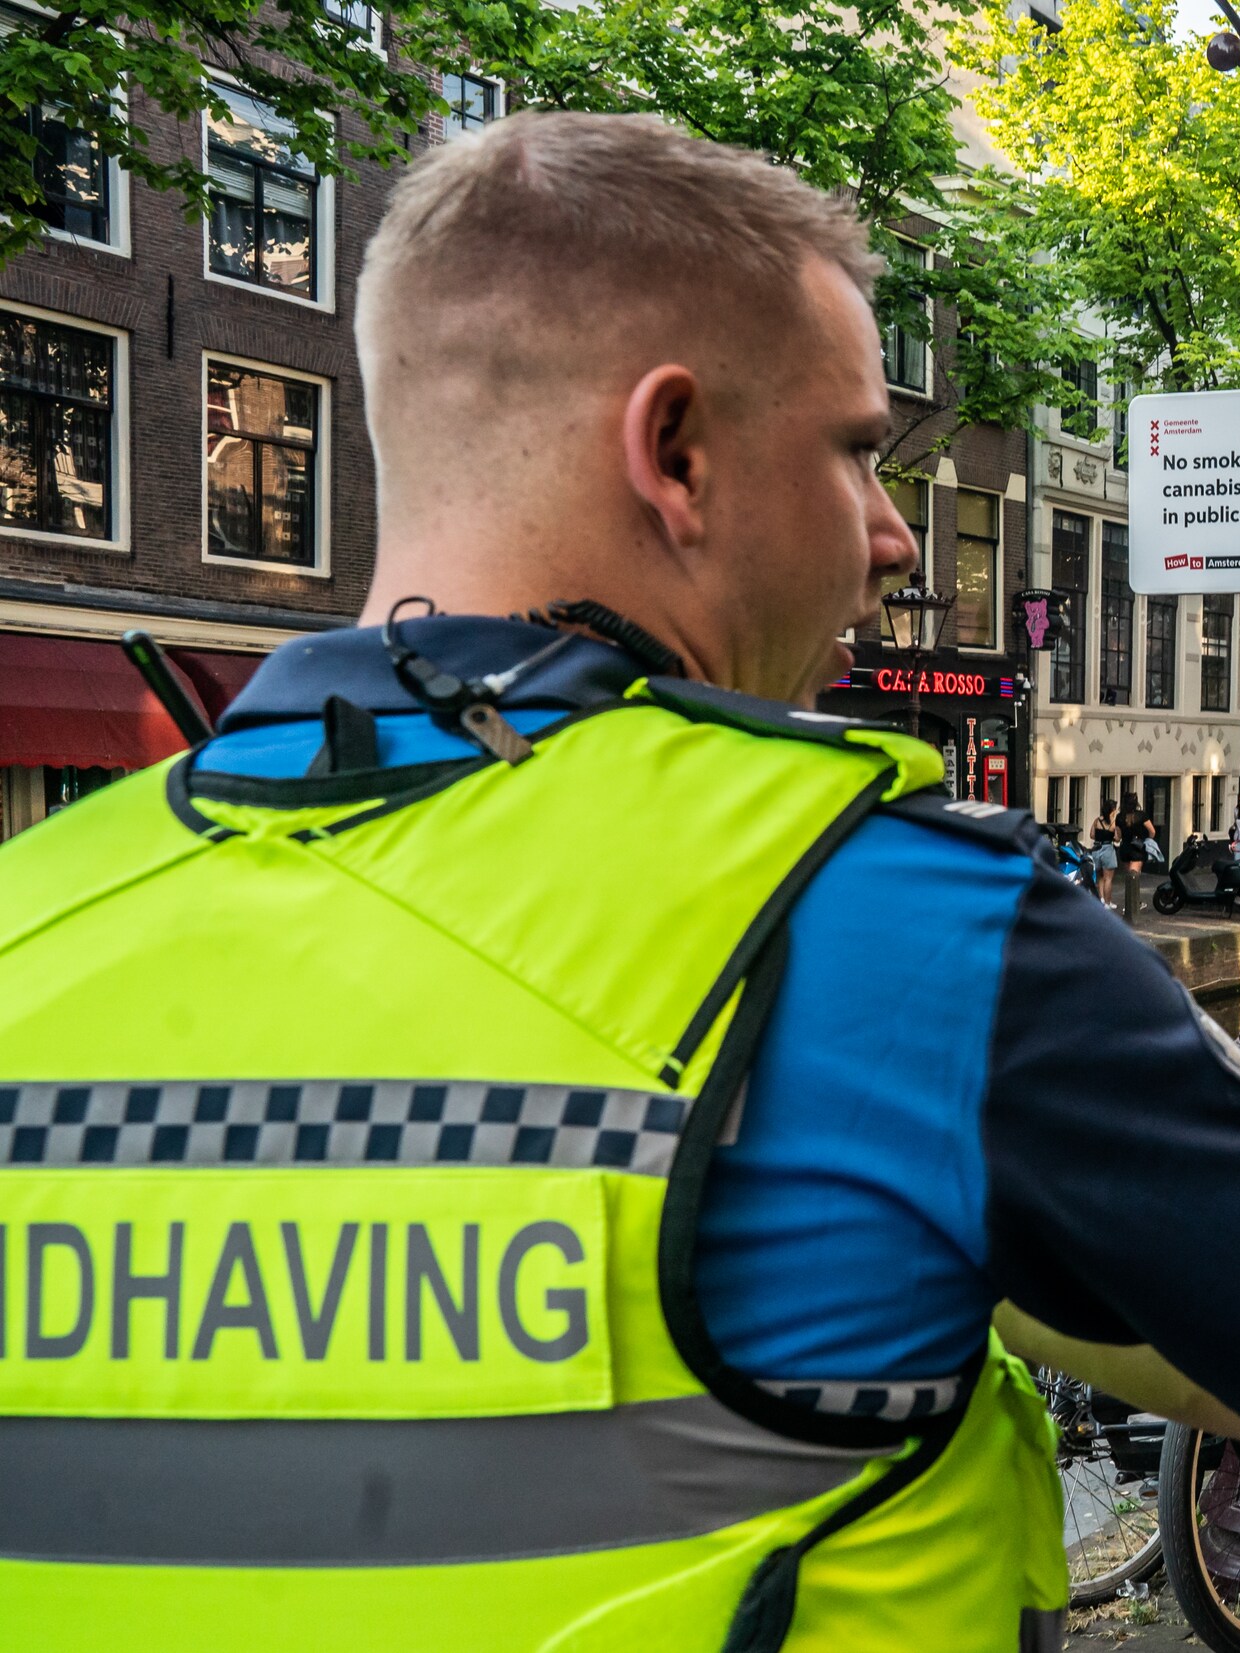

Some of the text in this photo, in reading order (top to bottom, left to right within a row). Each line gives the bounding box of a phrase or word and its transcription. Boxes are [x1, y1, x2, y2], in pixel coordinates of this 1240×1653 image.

[1163, 427, 1202, 435] Amsterdam
[1163, 454, 1188, 470] No
[1163, 507, 1178, 524] in
[1166, 558, 1186, 568] How
[1192, 559, 1202, 568] to
[932, 671, 985, 695] ROSSO
[0, 1219, 590, 1363] DHAVING
